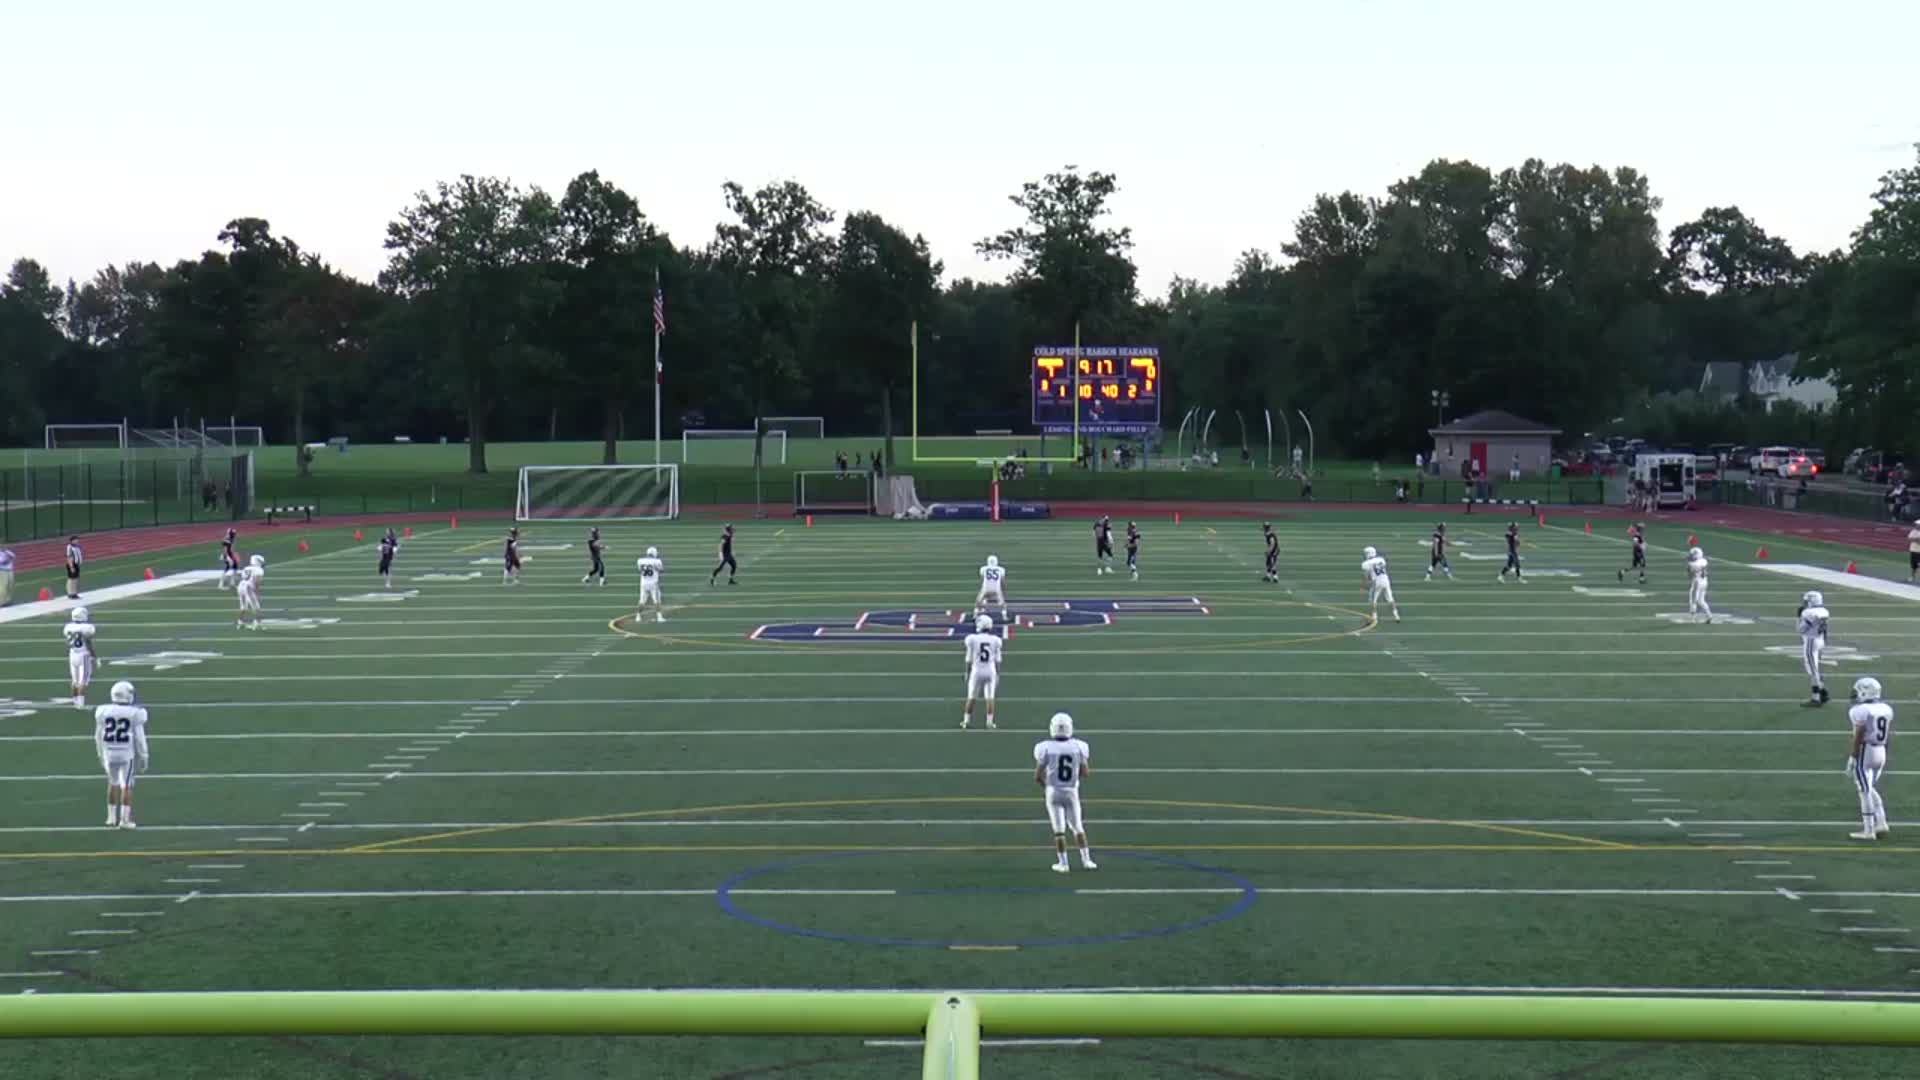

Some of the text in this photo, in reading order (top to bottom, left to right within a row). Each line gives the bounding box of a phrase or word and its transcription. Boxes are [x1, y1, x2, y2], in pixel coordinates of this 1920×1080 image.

[1034, 347, 1056, 356] COLD
[1086, 347, 1117, 356] HARBOR
[1080, 360, 1090, 374] 9
[1097, 360, 1112, 374] 17
[1059, 384, 1066, 398] 1
[1079, 384, 1093, 399] 10
[1102, 384, 1119, 399] 40
[1127, 384, 1137, 399] 2
[980, 642, 991, 663] 5
[103, 717, 131, 742] 22
[1876, 715, 1888, 742] 9
[1057, 754, 1073, 783] 6
